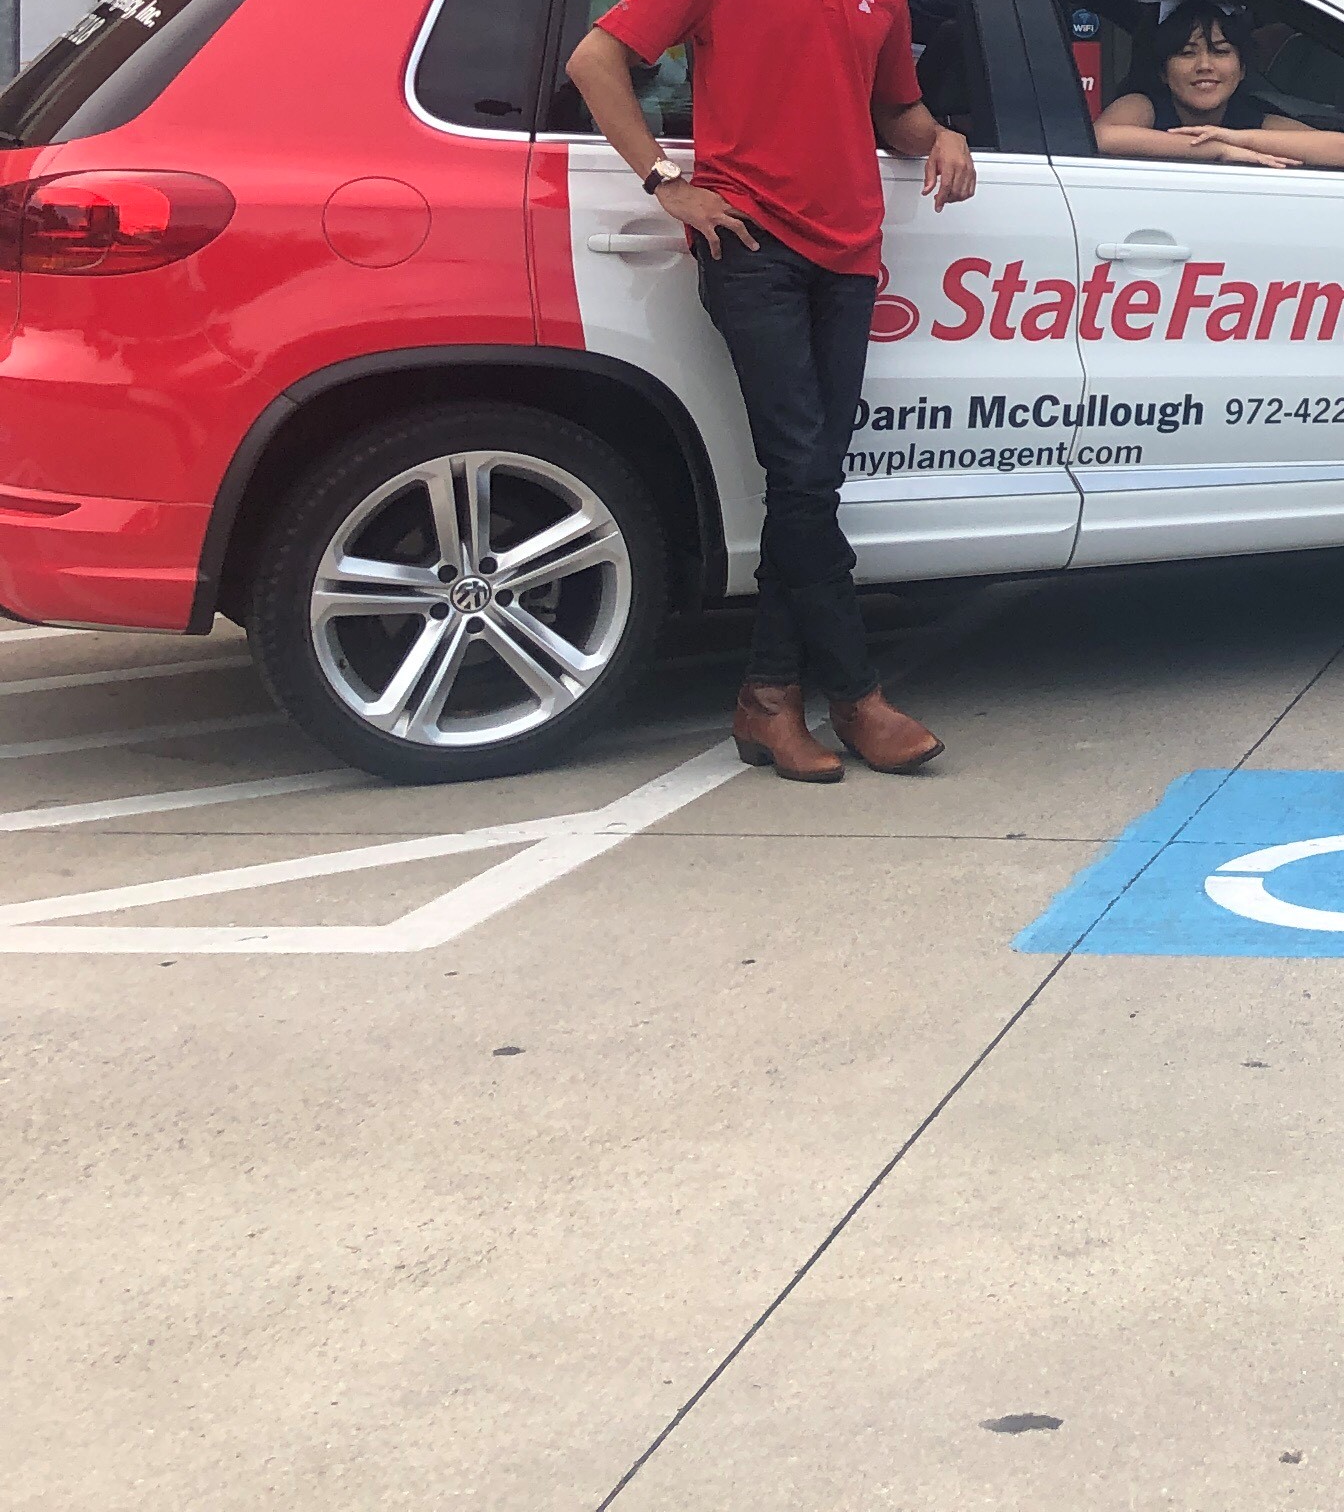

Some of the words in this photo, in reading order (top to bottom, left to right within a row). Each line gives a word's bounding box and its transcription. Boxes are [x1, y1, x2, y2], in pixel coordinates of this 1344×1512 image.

[853, 397, 952, 431] Darin
[968, 393, 1203, 434] McCullough
[843, 442, 1143, 477] myplanoagent.com
